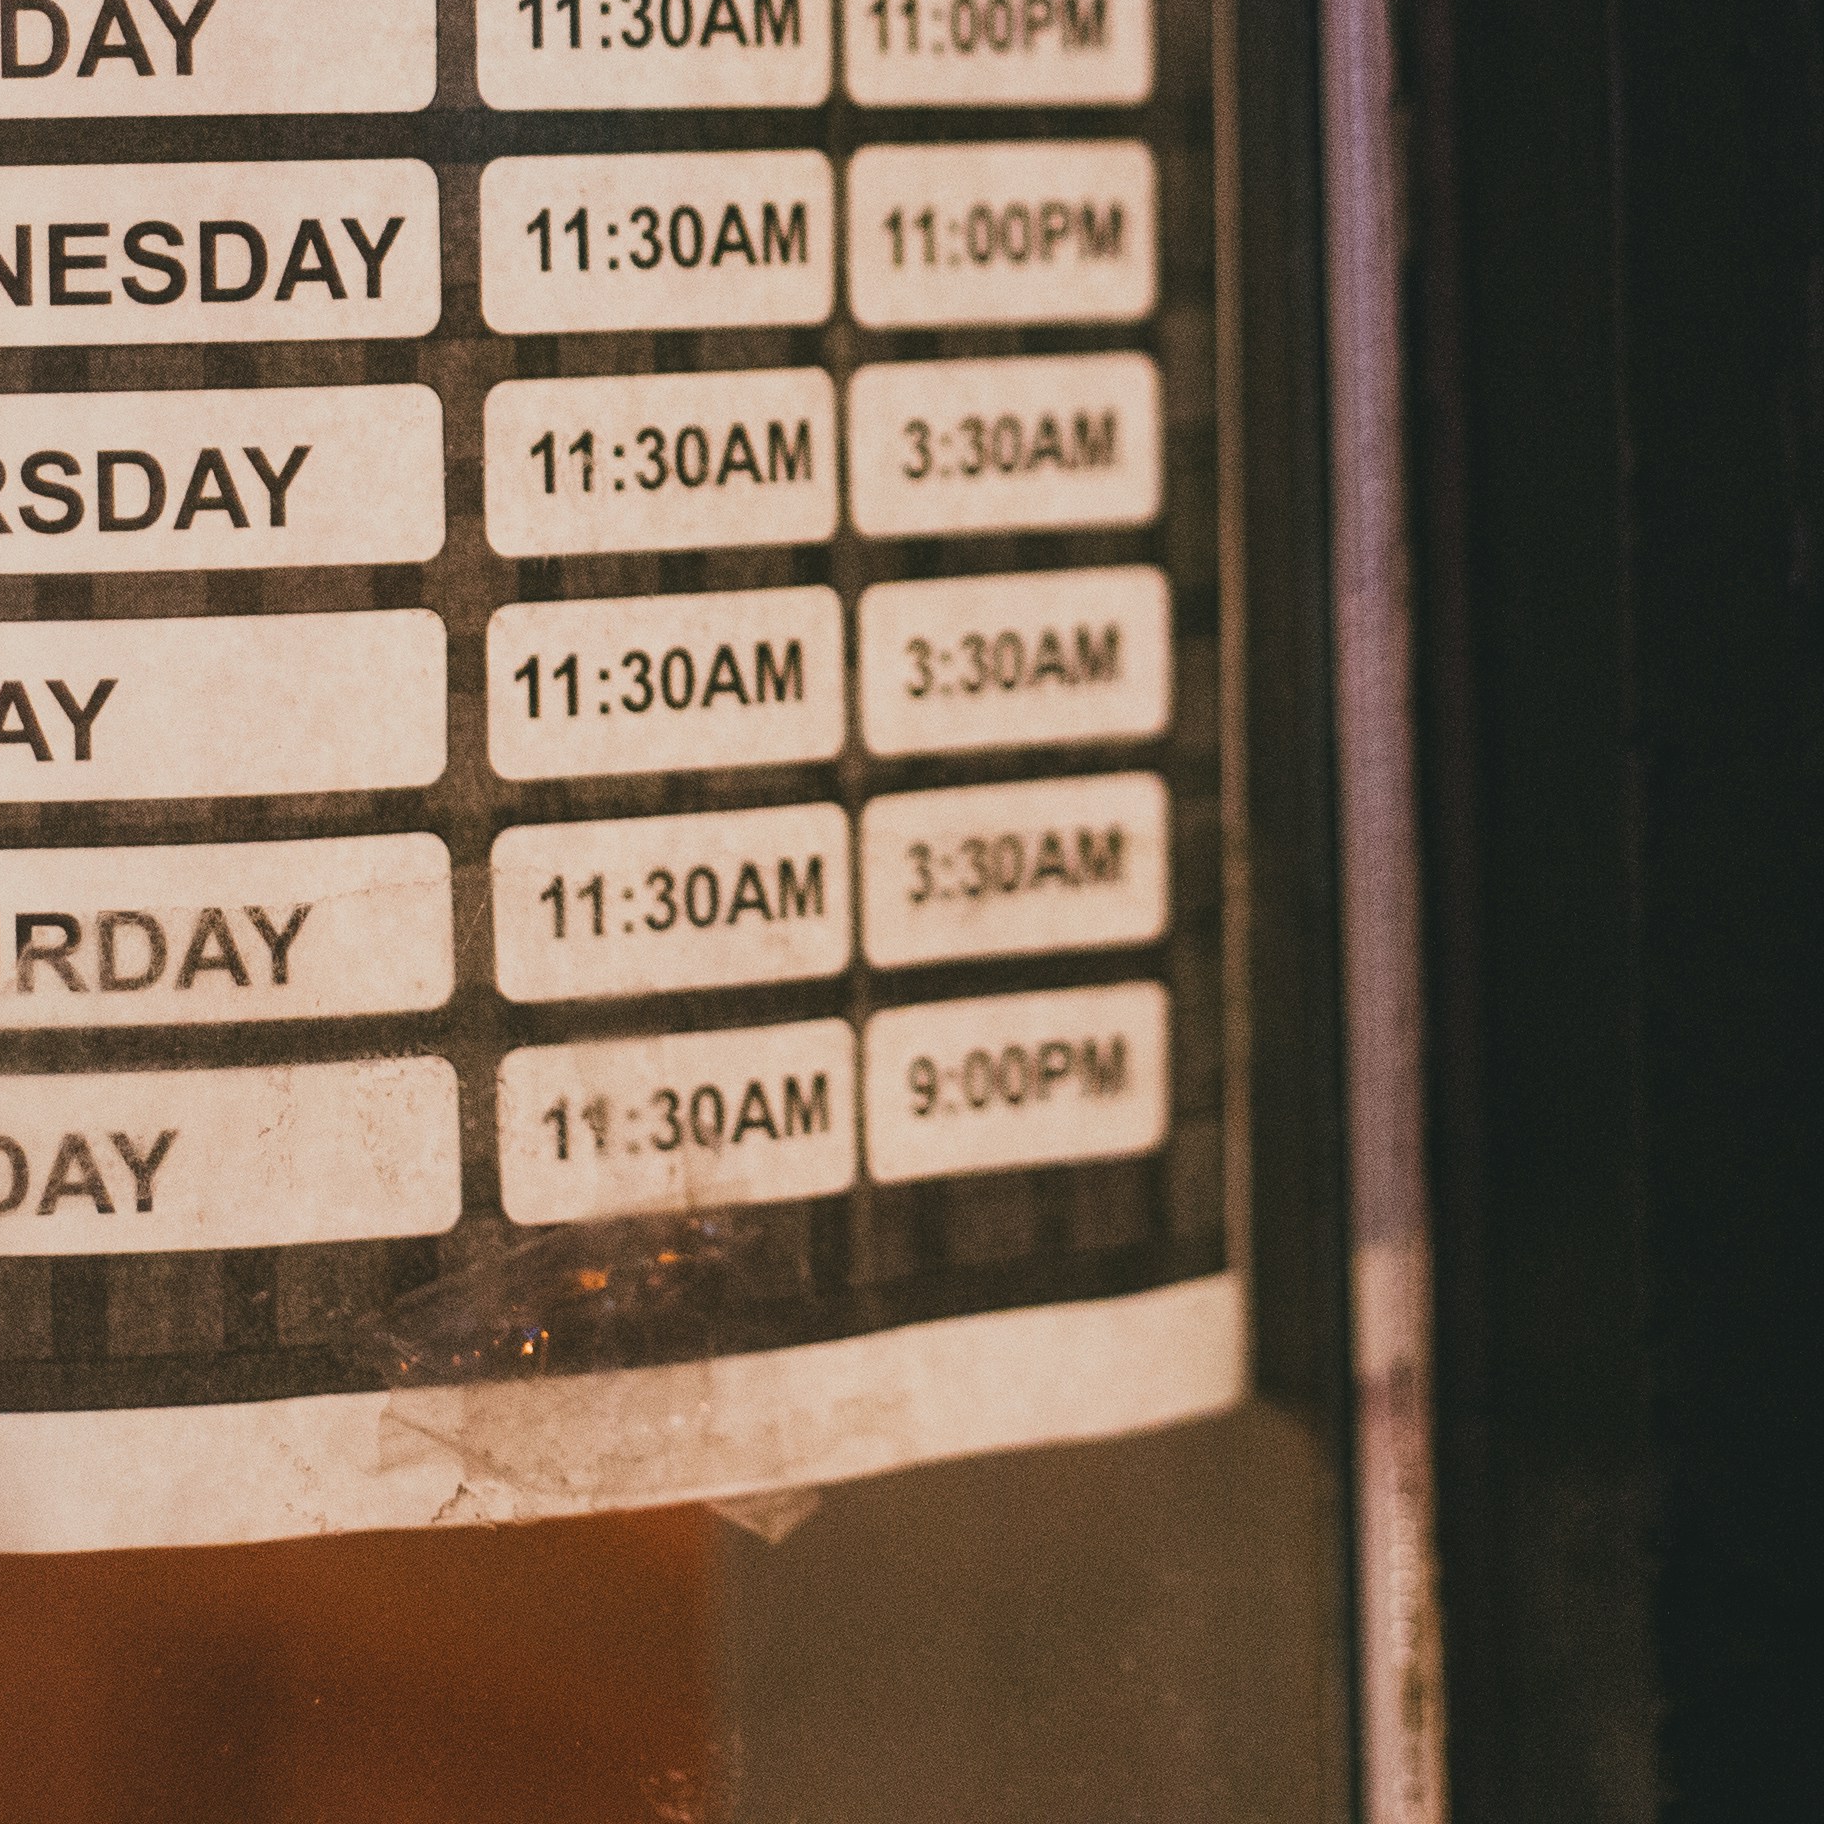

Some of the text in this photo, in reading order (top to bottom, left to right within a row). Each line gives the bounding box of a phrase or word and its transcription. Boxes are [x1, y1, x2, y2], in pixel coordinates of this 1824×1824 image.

[526, 202, 808, 272] 11:30AM
[884, 202, 1127, 266] 11:00PM
[530, 420, 812, 494] 11:30AM
[904, 411, 1118, 482] 3:30AM
[514, 640, 804, 719] 11:30AM
[908, 625, 1121, 700] 3:30AM
[540, 855, 824, 939] 11:30AM
[910, 827, 1127, 906] 3:30AM
[544, 1073, 829, 1161] 11:30AM
[910, 1036, 1129, 1118] 9:00PM
